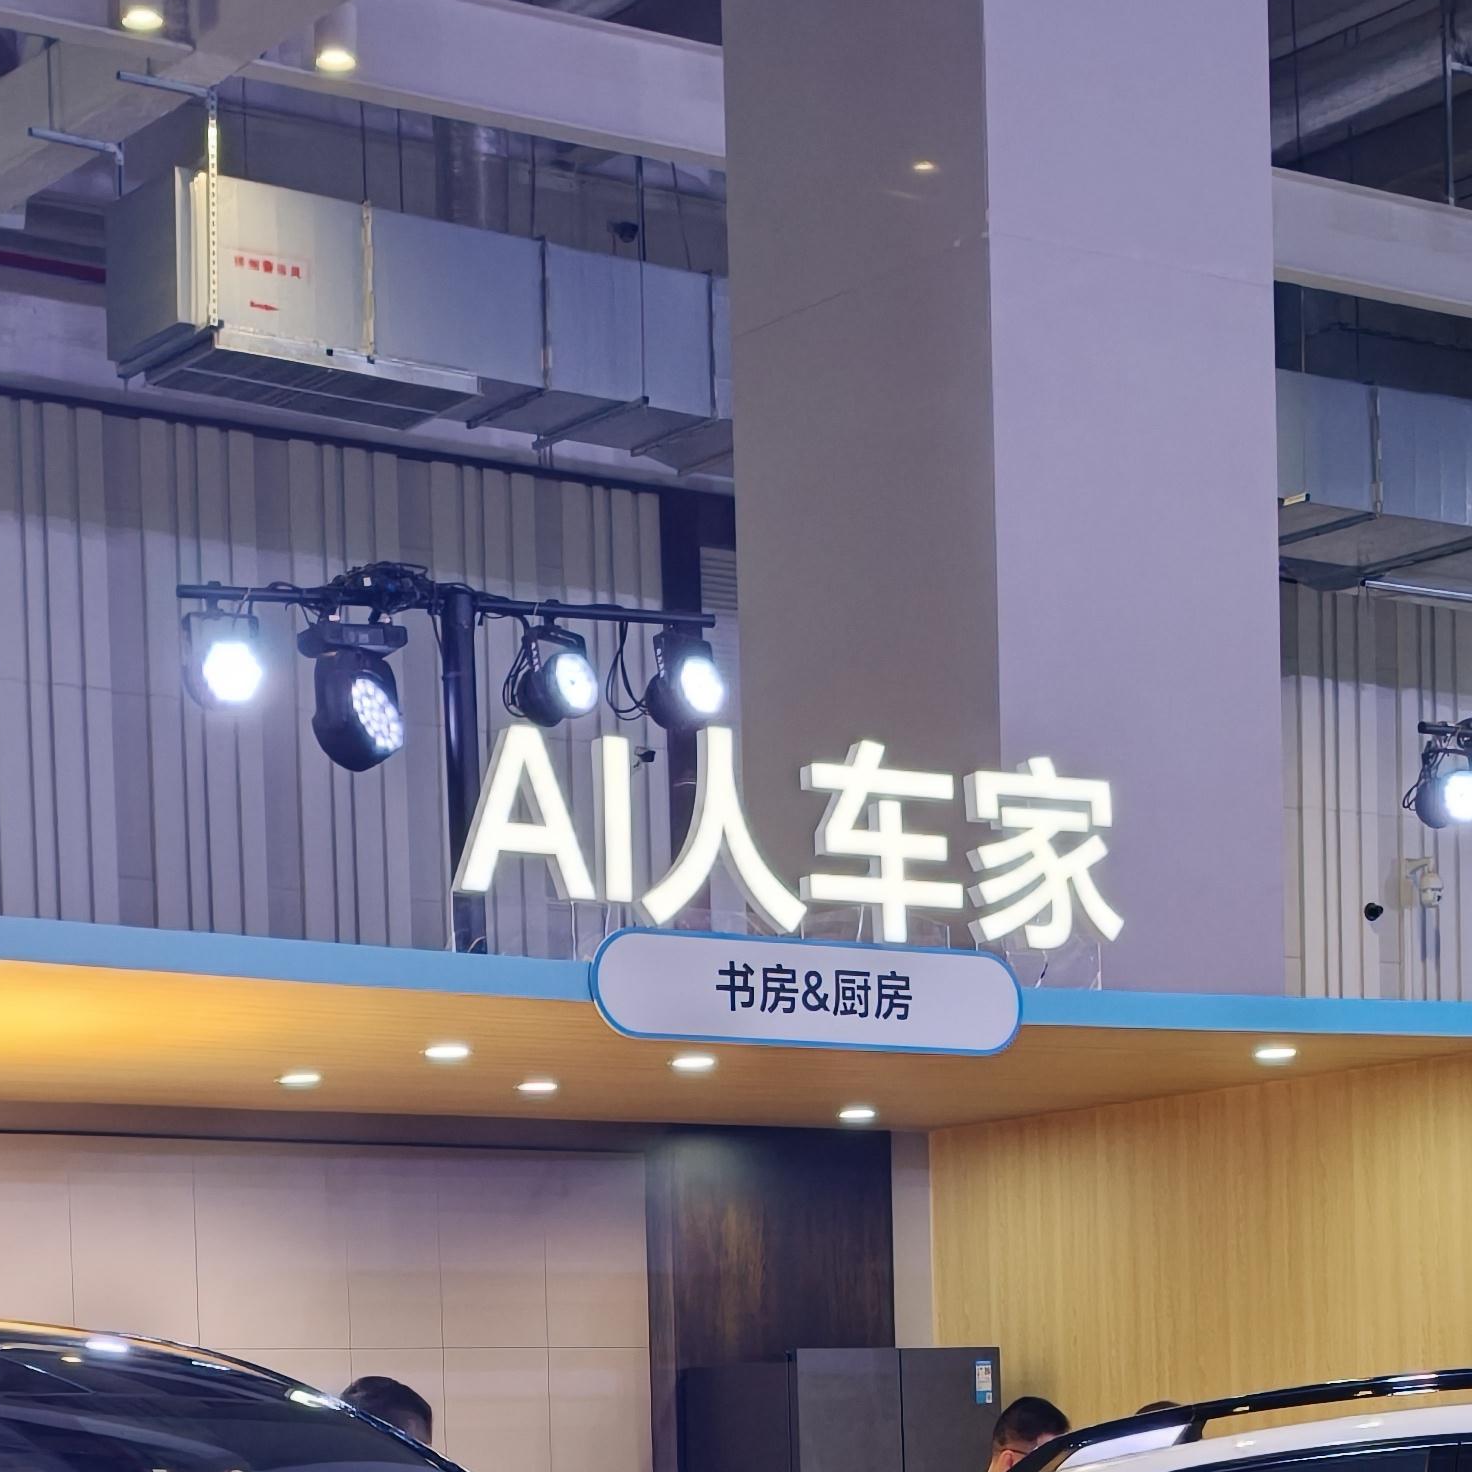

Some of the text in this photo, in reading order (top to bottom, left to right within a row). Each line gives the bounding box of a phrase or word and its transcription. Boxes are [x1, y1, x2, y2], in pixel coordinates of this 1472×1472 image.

[455, 725, 1125, 950] AI人车家
[715, 960, 913, 1021] 书房&厨房
